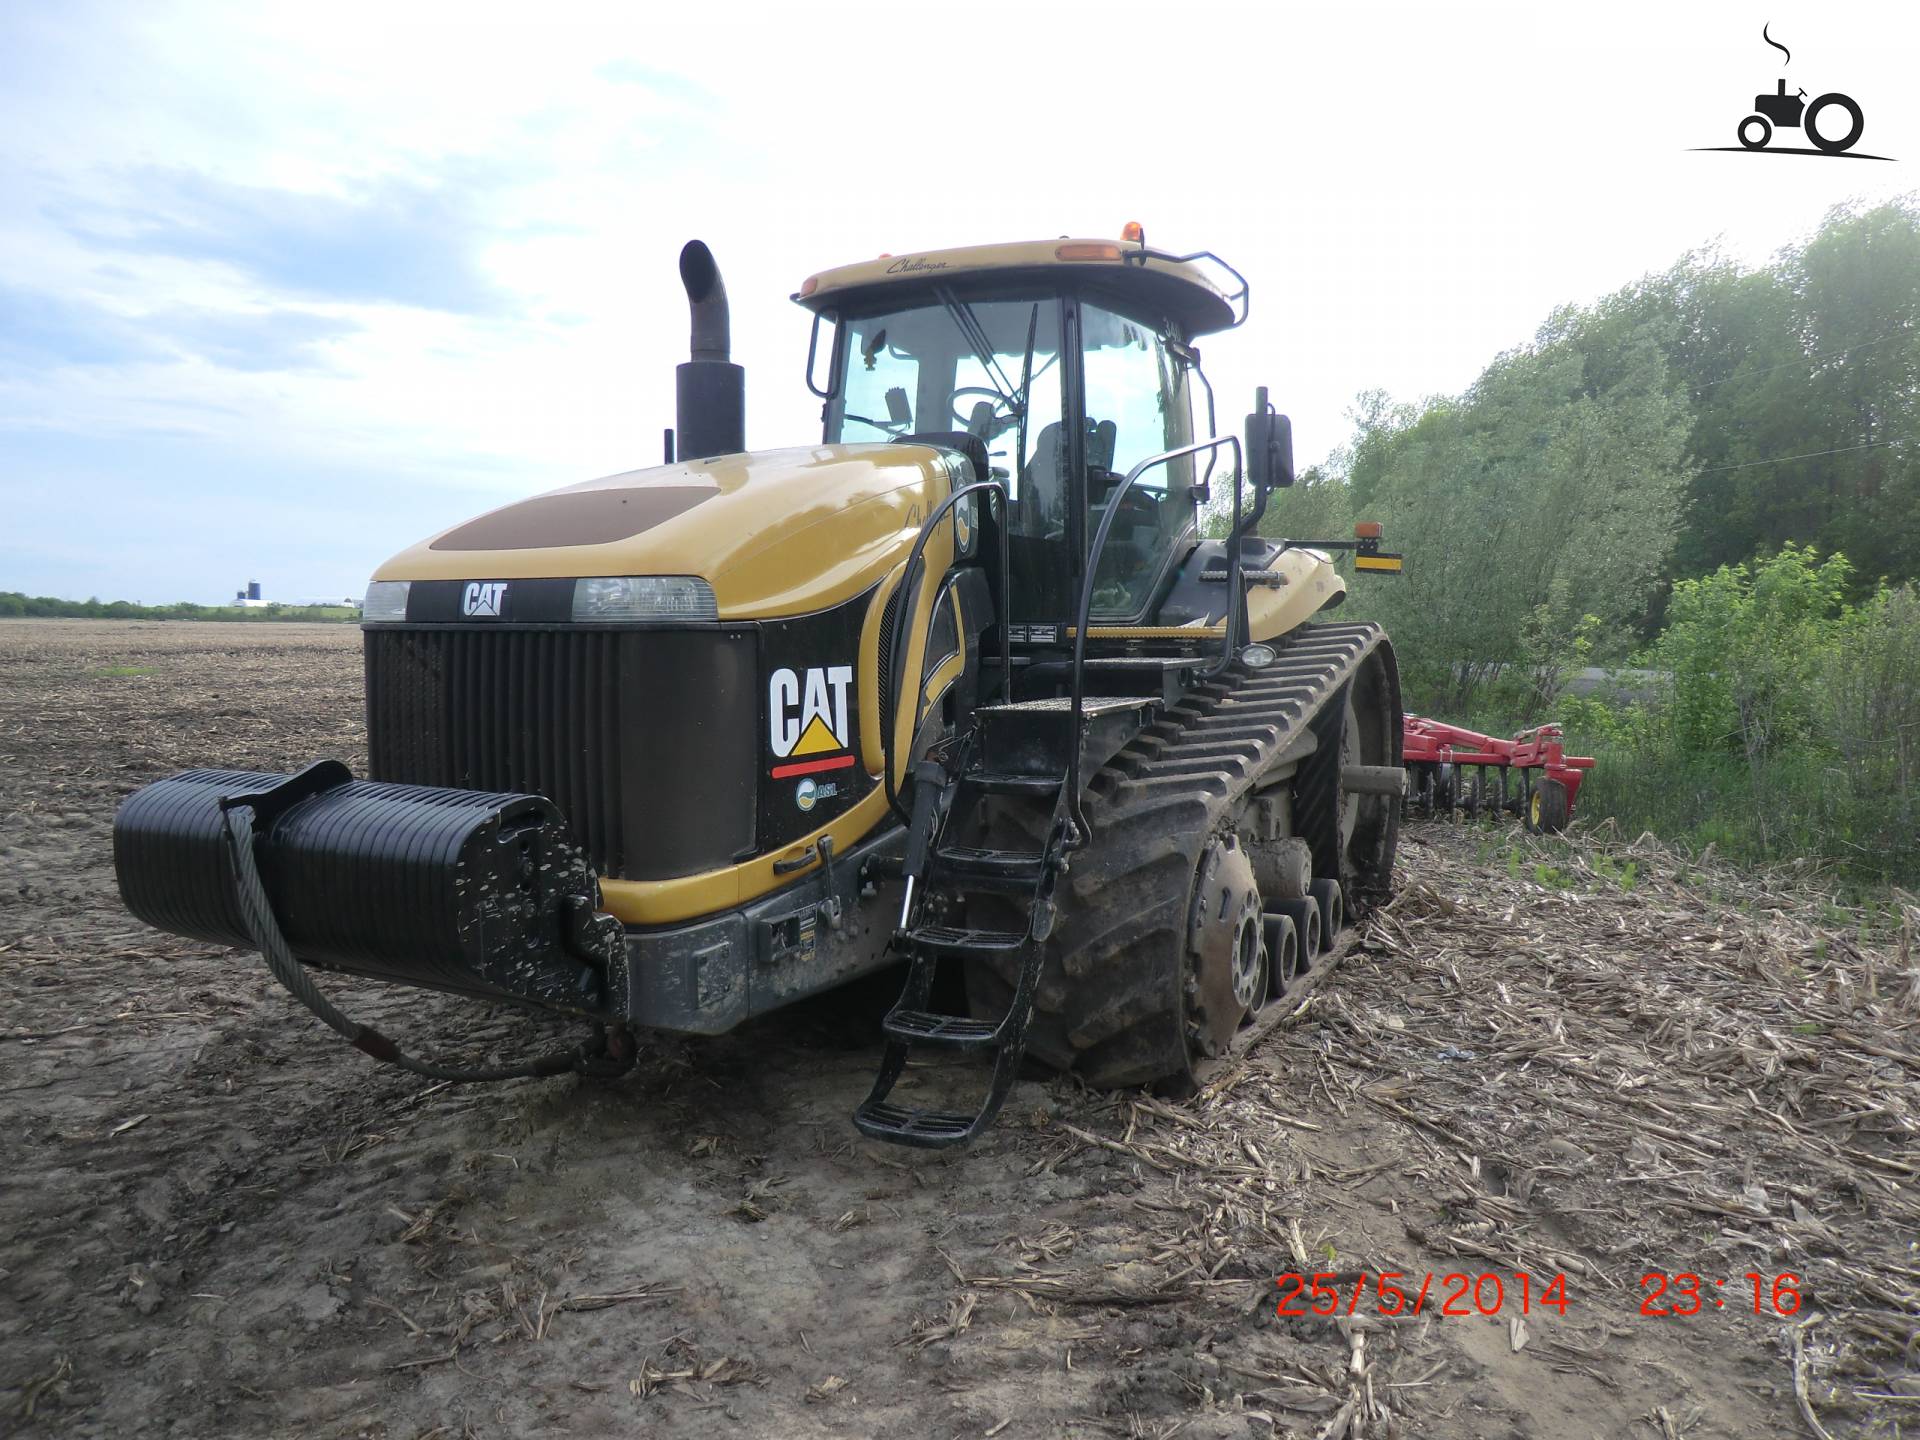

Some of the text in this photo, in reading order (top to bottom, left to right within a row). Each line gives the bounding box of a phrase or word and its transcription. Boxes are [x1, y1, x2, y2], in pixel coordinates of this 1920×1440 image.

[886, 257, 955, 275] Challenger
[464, 582, 508, 616] CAT
[770, 665, 853, 758] CAT
